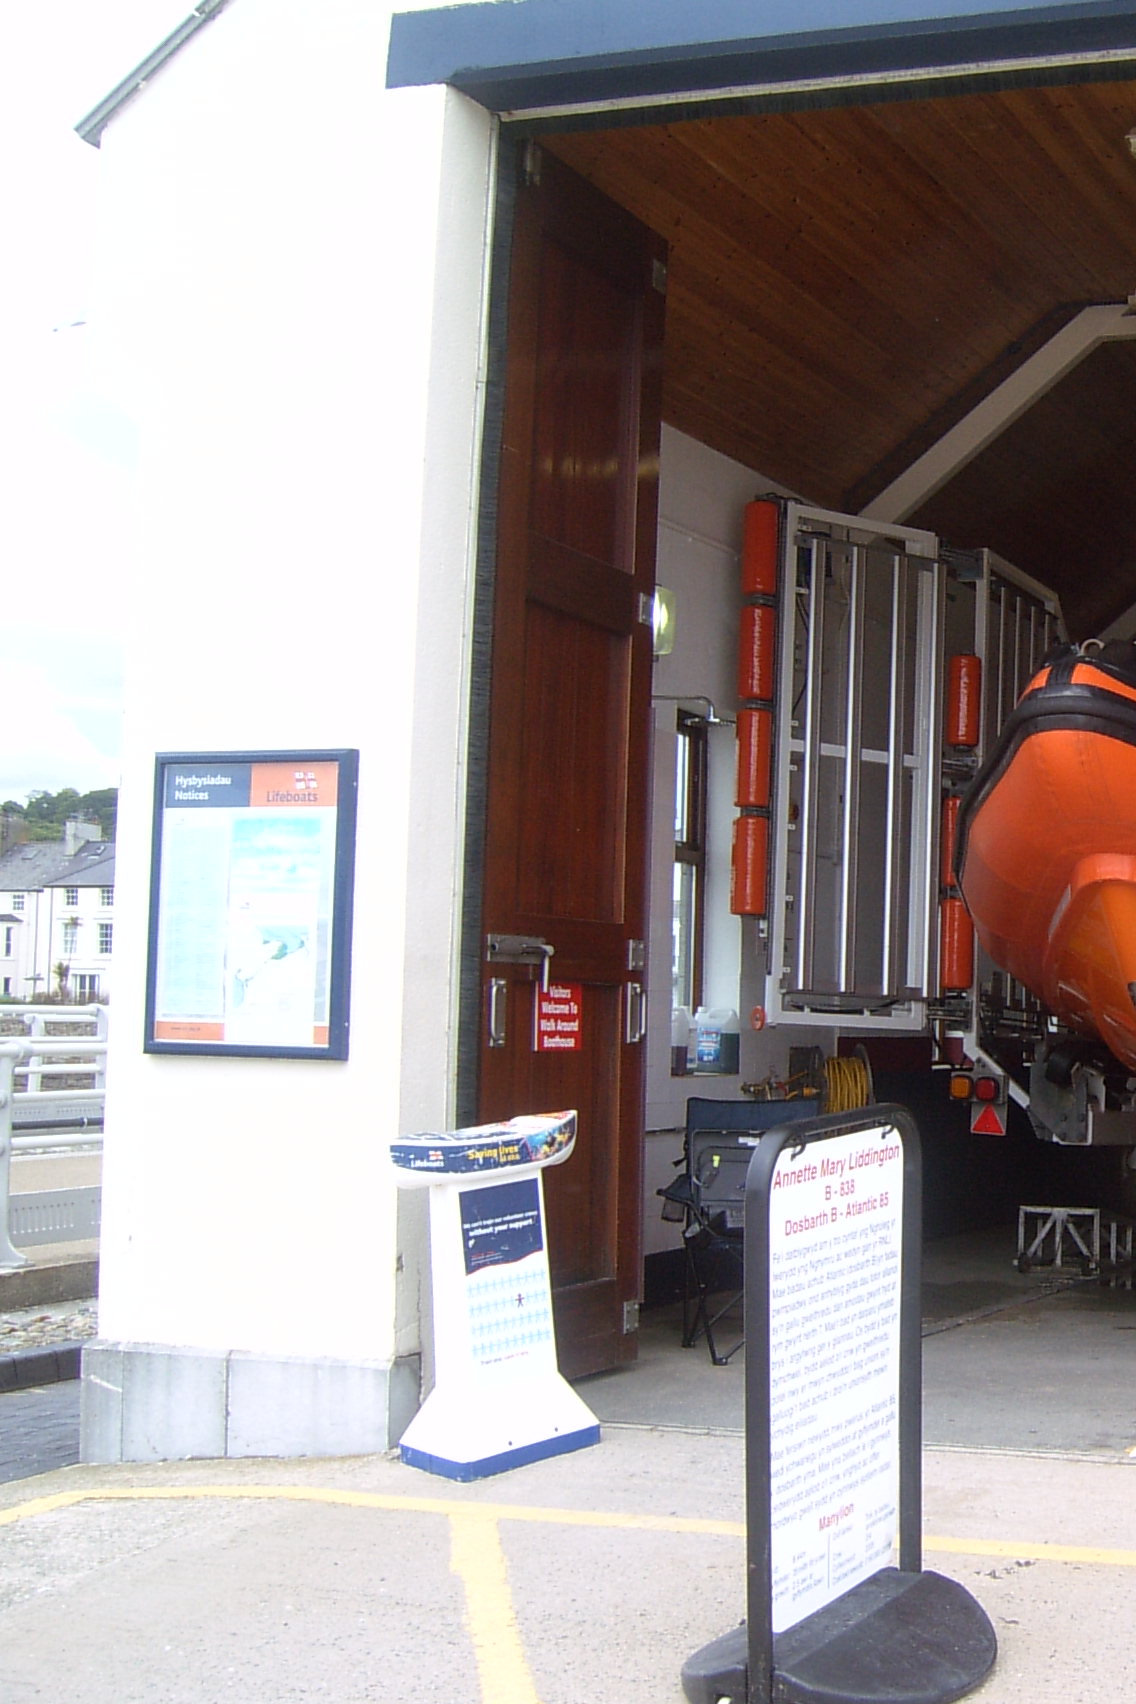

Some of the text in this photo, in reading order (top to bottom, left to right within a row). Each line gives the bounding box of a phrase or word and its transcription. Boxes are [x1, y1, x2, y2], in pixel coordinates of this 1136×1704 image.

[175, 774, 232, 788] Hysbysiadau
[174, 790, 210, 800] Notices
[266, 790, 318, 802] Lifeboats
[773, 1144, 900, 1190] Annette Mary Liddington
[825, 1185, 832, 1201] B
[840, 1179, 856, 1197] 838
[785, 1210, 828, 1236] Dosbarth
[830, 1206, 838, 1223] B
[846, 1195, 878, 1219] Atlantic
[819, 1503, 854, 1532] Manylion
